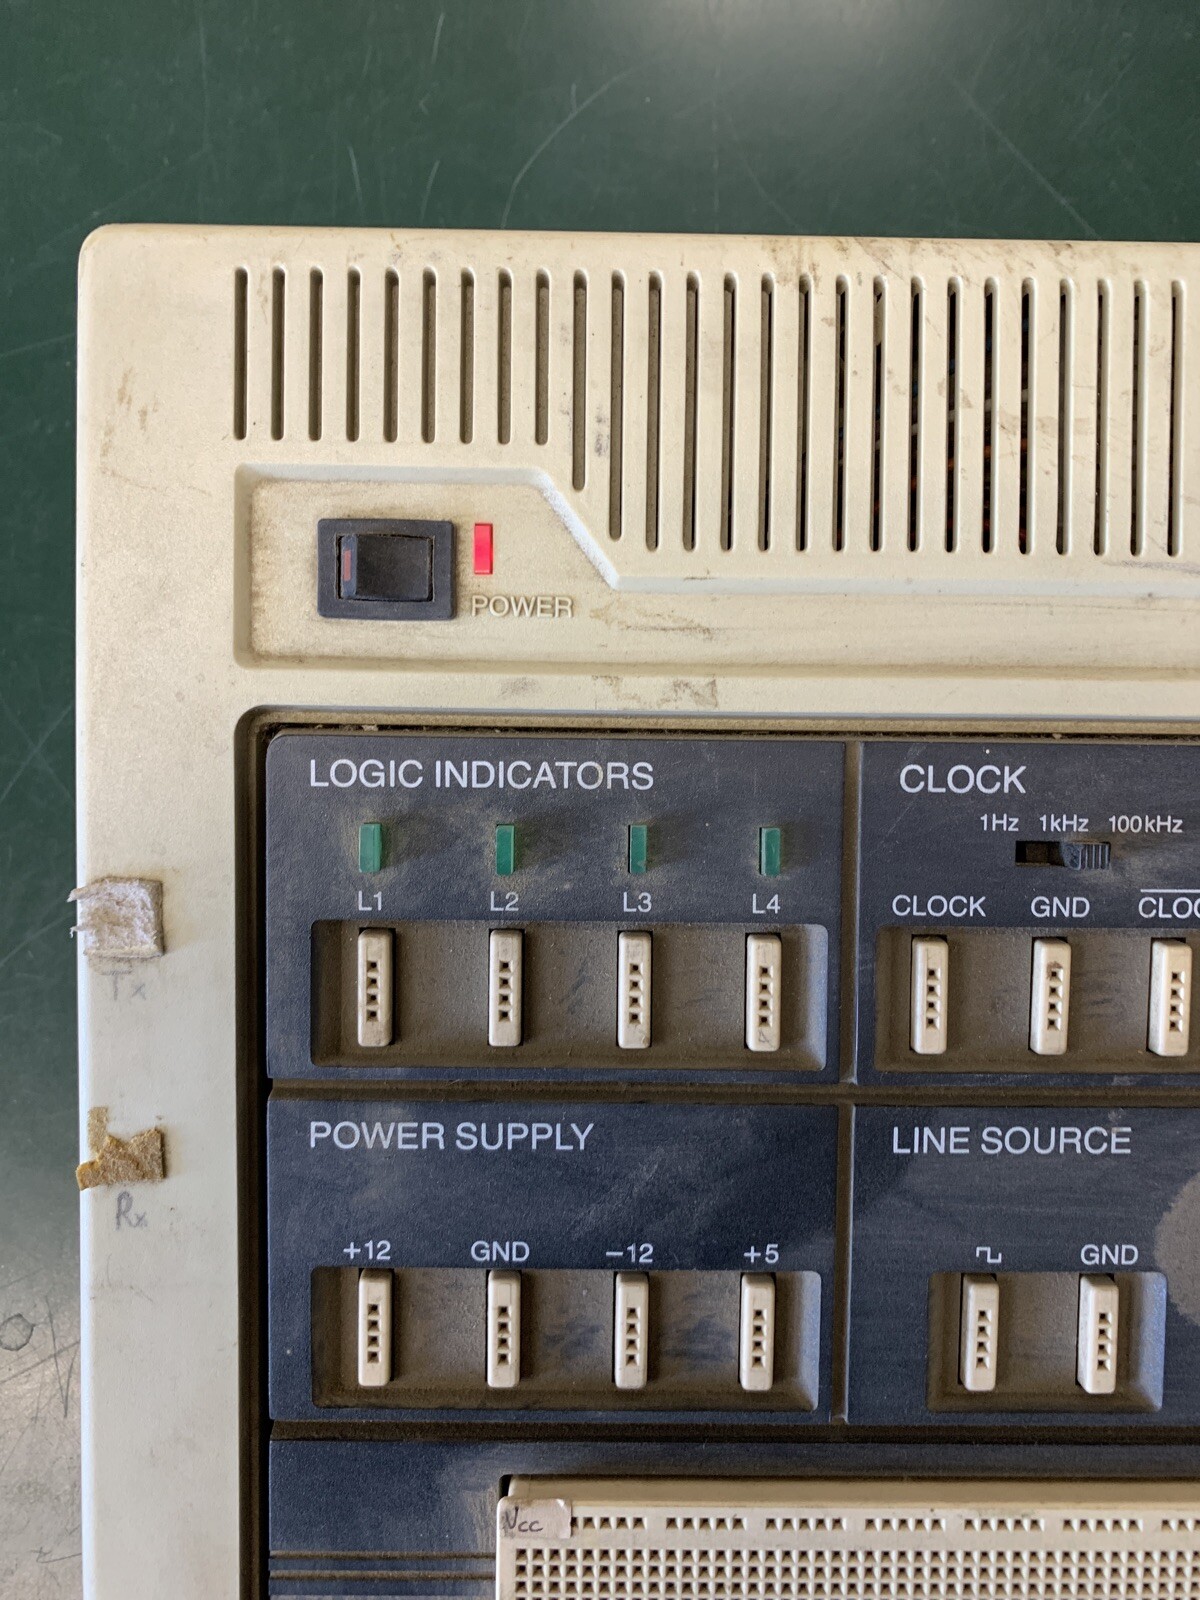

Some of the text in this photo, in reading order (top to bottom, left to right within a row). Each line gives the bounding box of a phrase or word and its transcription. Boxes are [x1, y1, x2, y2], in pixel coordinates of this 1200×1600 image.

[471, 594, 574, 618] POWER
[309, 758, 655, 791] LOGIC INDICATORS
[899, 764, 1027, 795] CLOCK
[980, 813, 1019, 832] 1Hz
[1039, 814, 1089, 832] 1kHz
[357, 891, 383, 911] L1
[490, 892, 519, 911] L2
[623, 892, 652, 913] L3
[752, 893, 781, 914] L4
[891, 894, 987, 917] CLOCK
[1030, 896, 1091, 918] GND
[309, 1121, 595, 1151] POWER SUPPLY
[892, 1126, 1133, 1155] LINE SOURCE
[343, 1240, 392, 1261] +12
[470, 1240, 531, 1262] GND
[743, 1243, 780, 1264] +5
[1080, 1244, 1139, 1266] GND
